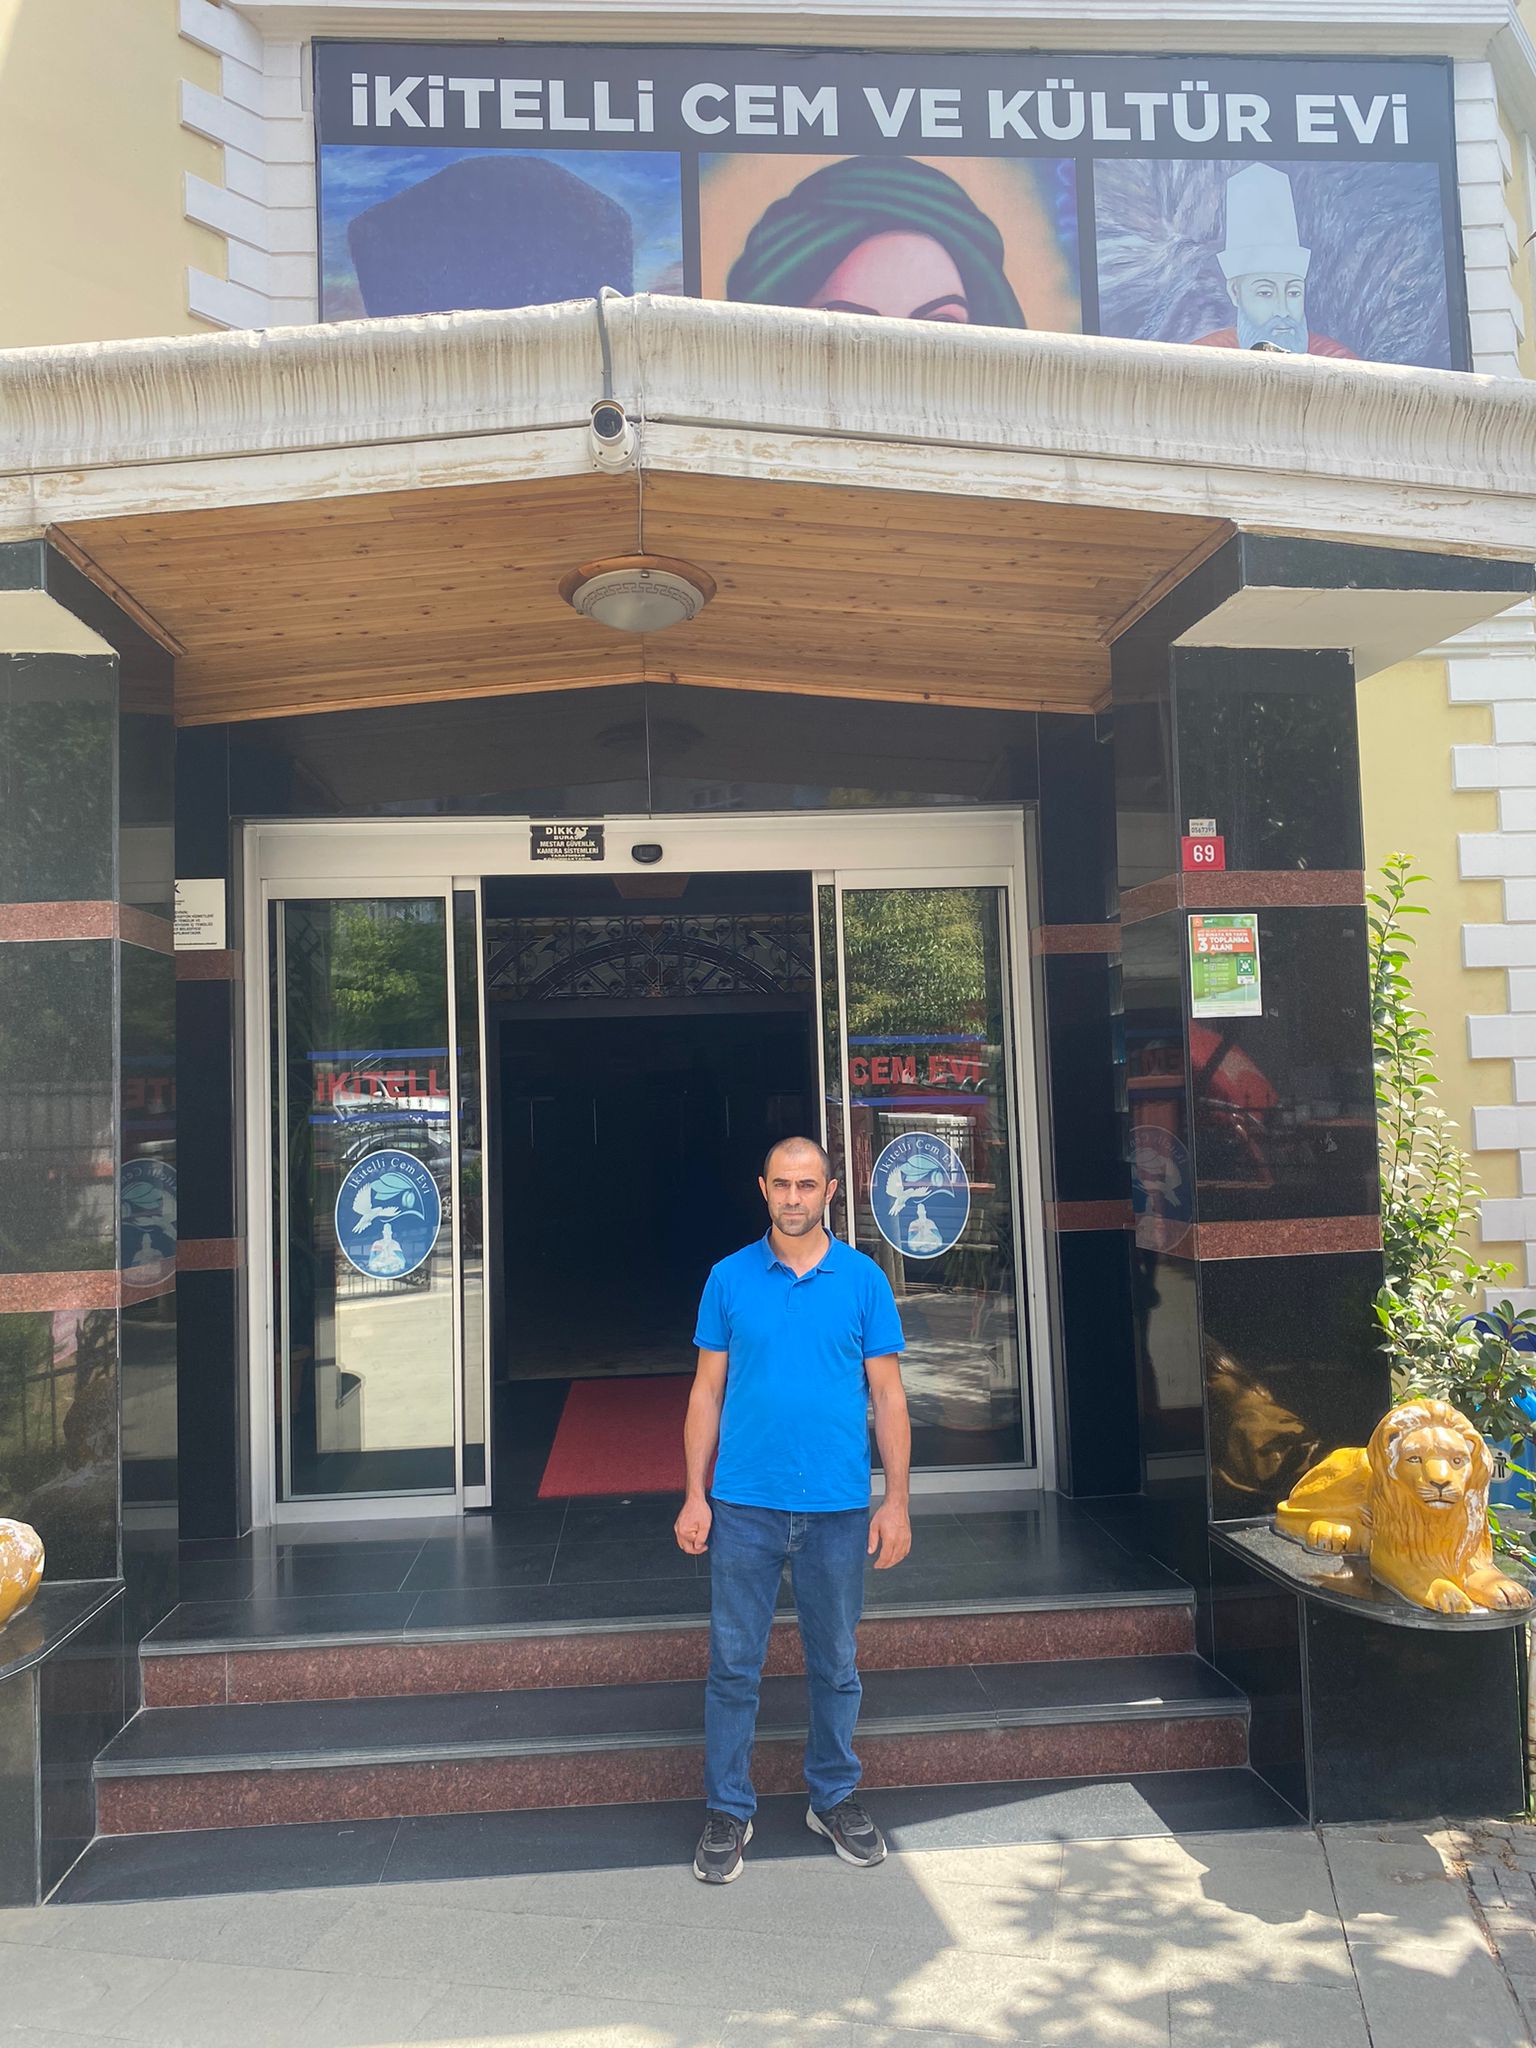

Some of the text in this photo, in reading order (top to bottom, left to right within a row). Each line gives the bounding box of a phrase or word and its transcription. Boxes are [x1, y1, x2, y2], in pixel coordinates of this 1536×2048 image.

[681, 83, 838, 136] CEM
[862, 87, 963, 138] VE
[988, 78, 1272, 143] KÜLTÜR
[1193, 844, 1215, 863] 69
[1198, 937, 1208, 952] 3
[1210, 936, 1250, 944] TOPLANMA
[849, 1056, 917, 1086] CEM
[915, 1140, 940, 1155] Cem
[390, 1157, 416, 1175] Cem
[416, 1174, 433, 1194] Evi
